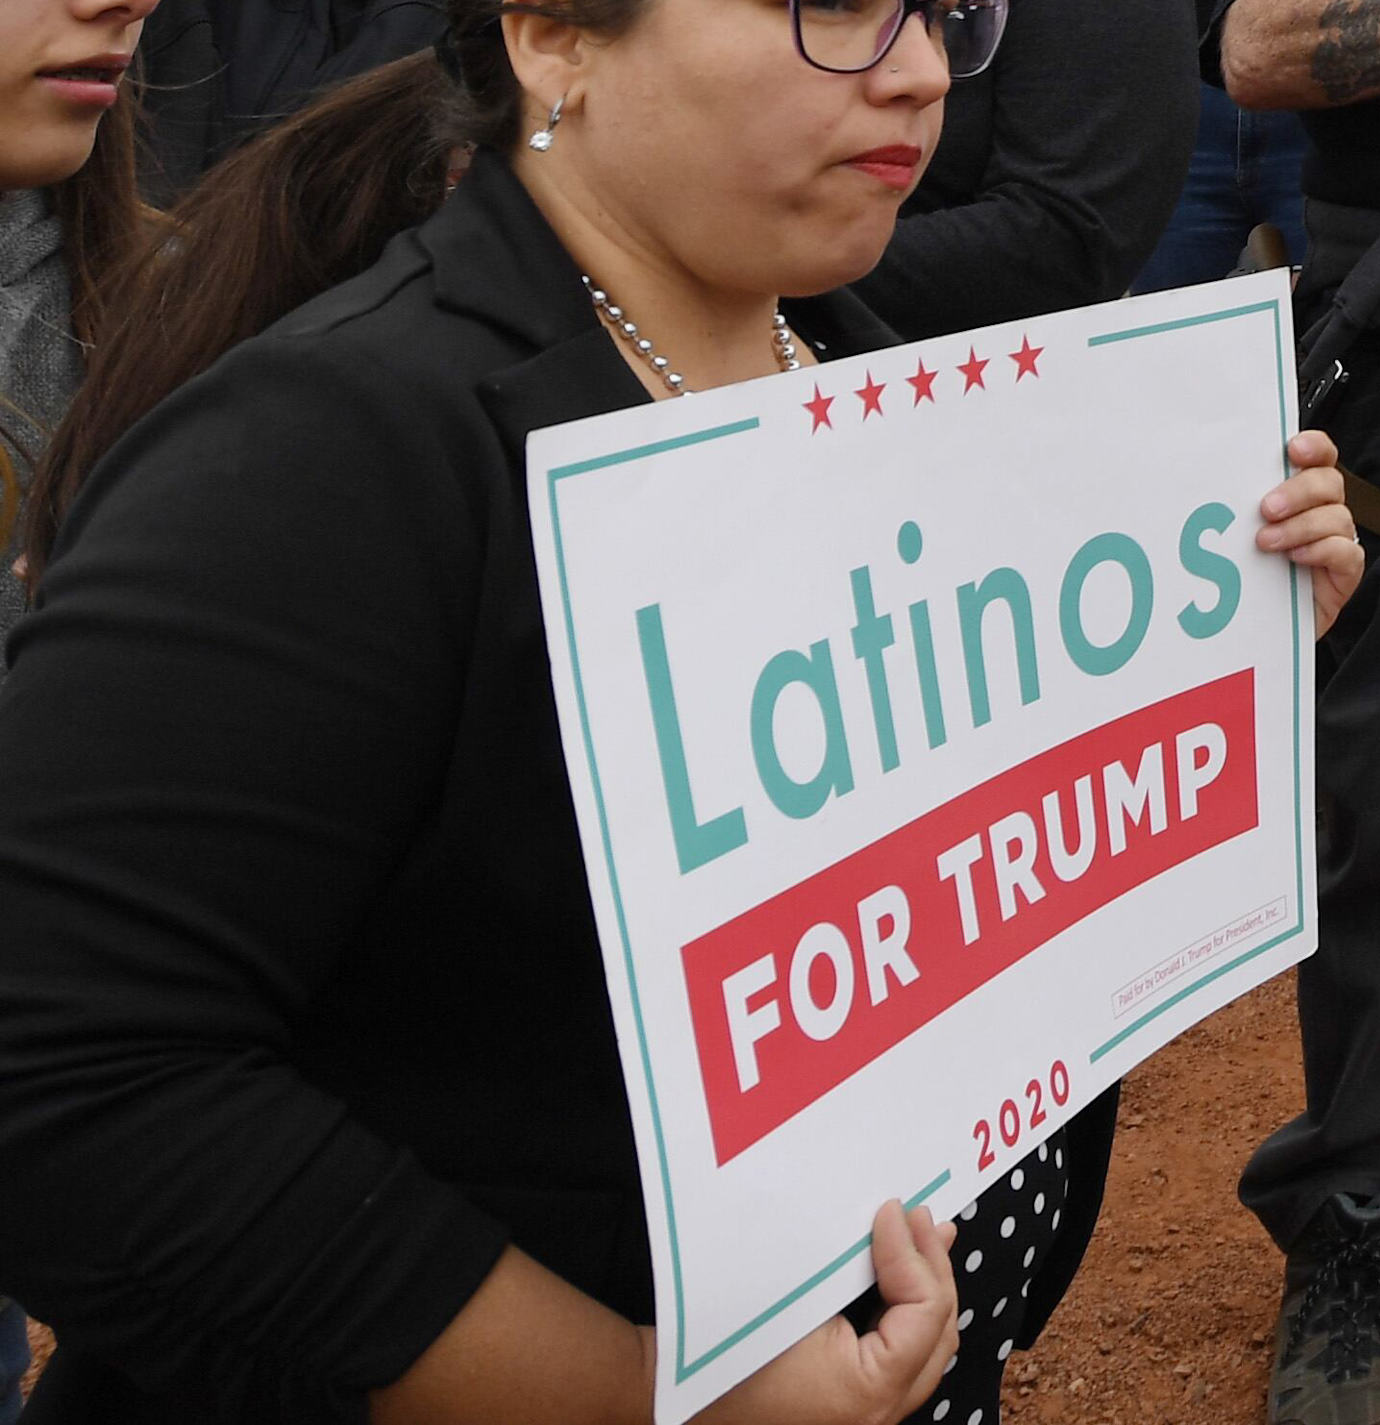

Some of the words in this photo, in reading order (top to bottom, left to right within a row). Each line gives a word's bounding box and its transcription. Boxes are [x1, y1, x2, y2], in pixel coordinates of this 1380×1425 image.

[636, 501, 1243, 875] Latinos
[721, 882, 919, 1095] FOR
[937, 722, 1228, 947] TRUMP
[973, 1059, 1073, 1172] 2020
